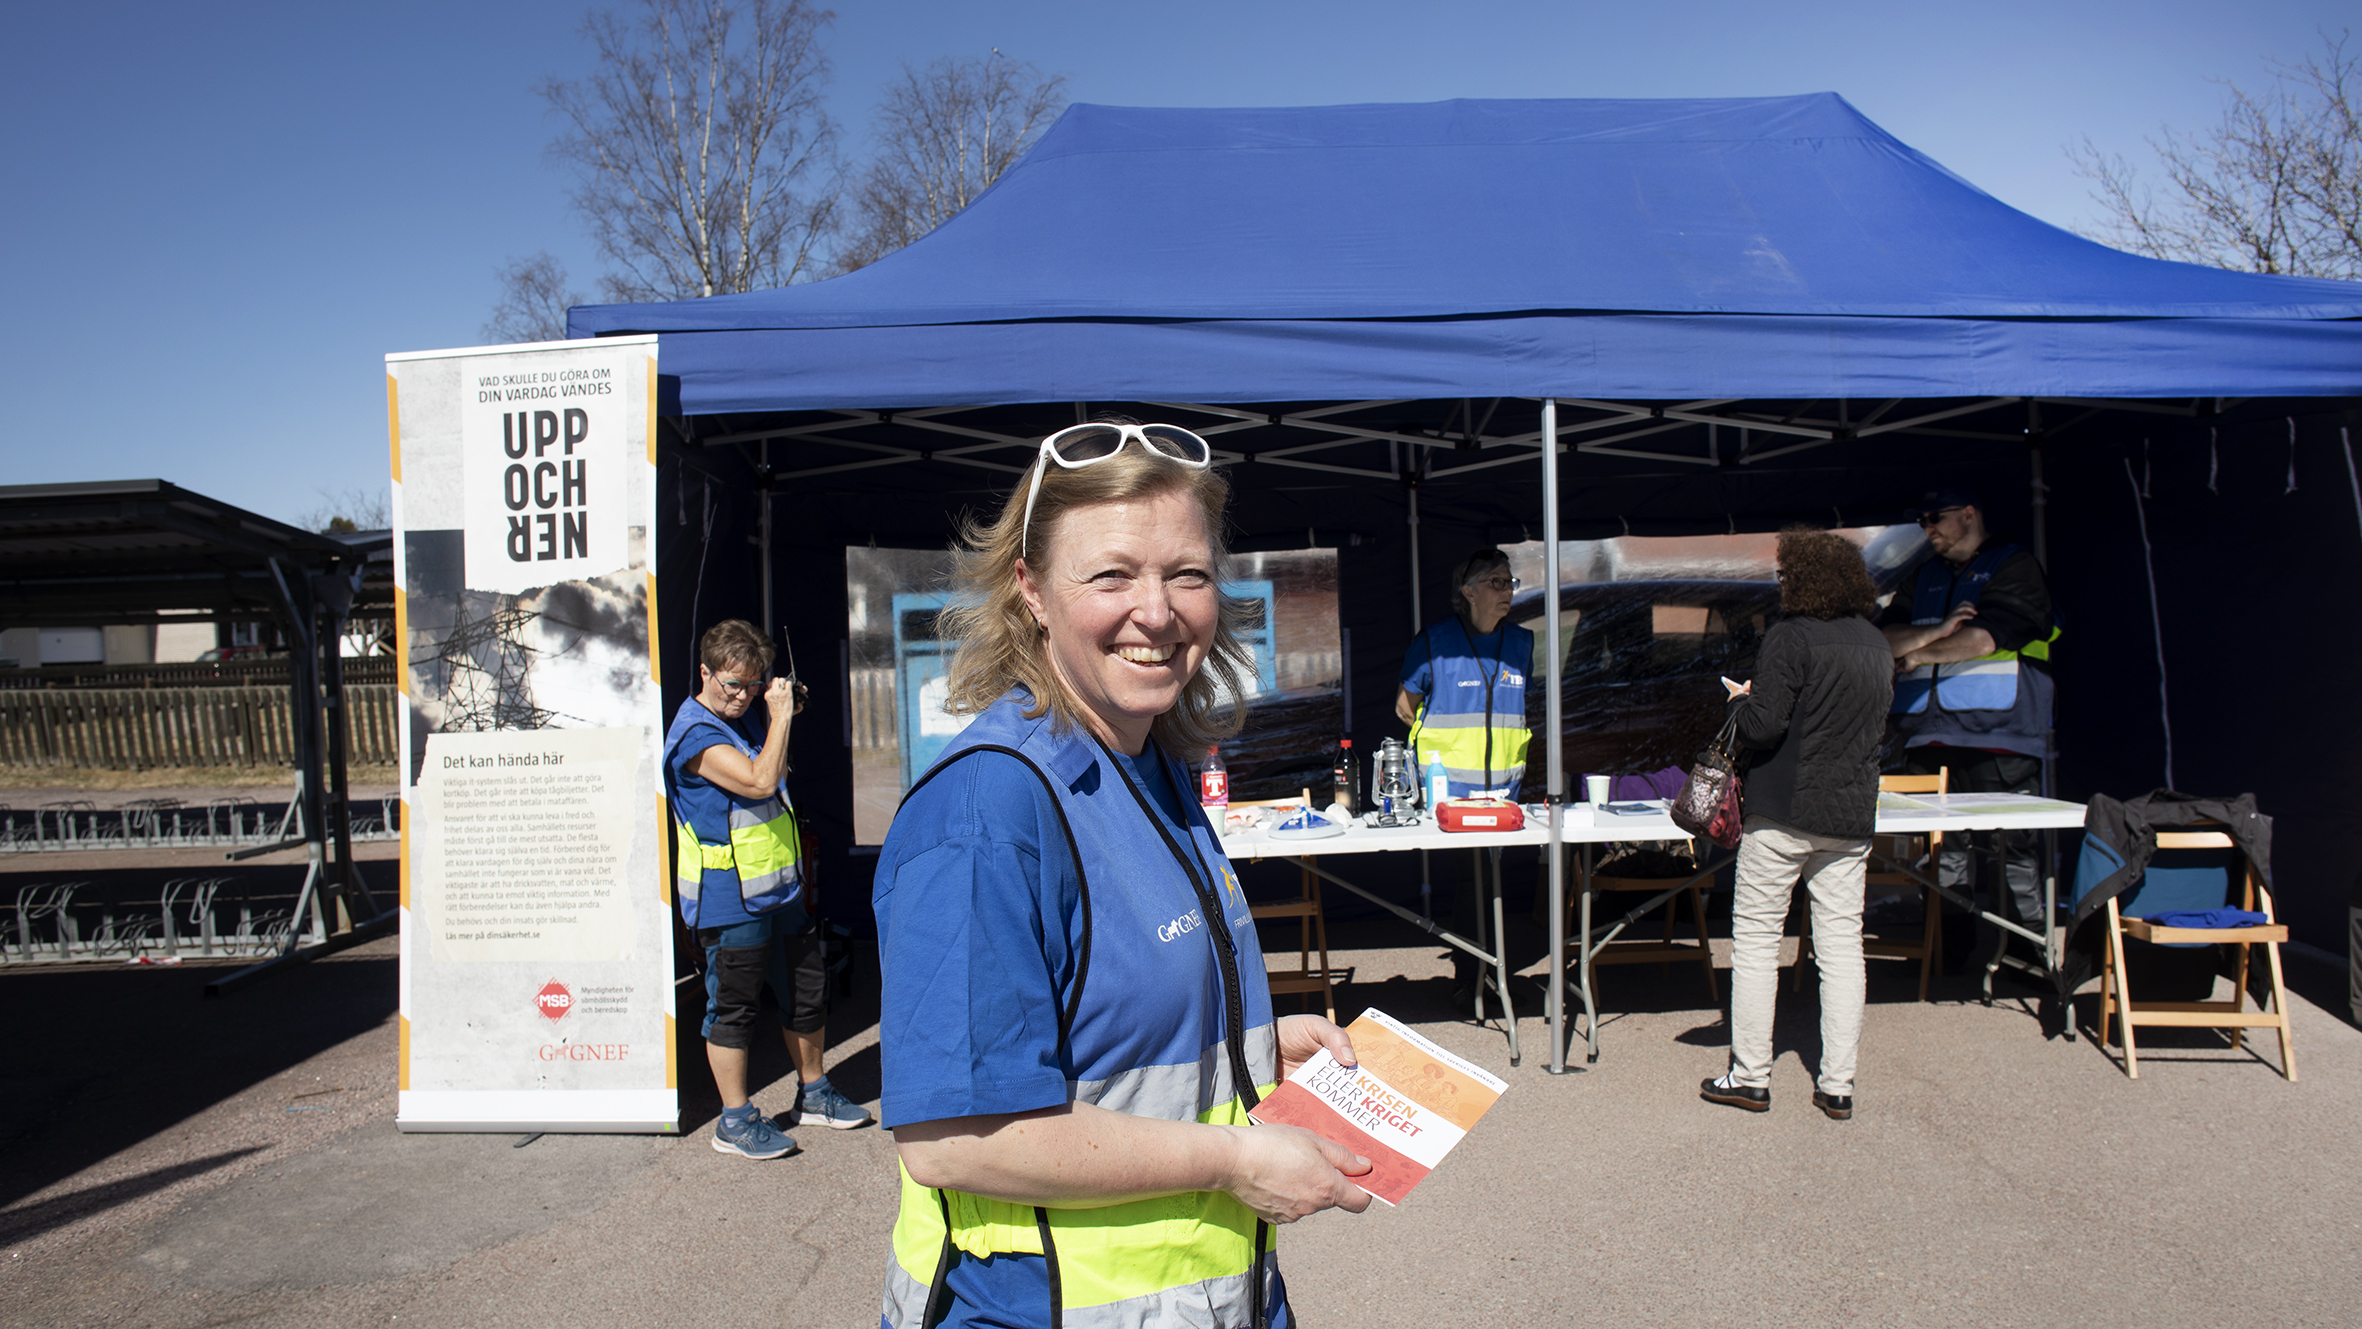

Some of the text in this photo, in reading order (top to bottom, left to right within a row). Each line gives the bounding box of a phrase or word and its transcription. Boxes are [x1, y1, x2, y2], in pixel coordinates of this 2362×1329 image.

[479, 368, 610, 386] VAD SKULLE DU GÖRA OM
[479, 382, 612, 403] DIN VARDAG VÄNDES
[503, 408, 588, 459] UPP
[504, 459, 586, 511] OCH
[507, 511, 588, 562] NER
[443, 752, 564, 769] Det kan hända här
[443, 777, 467, 788] Viktiga
[504, 775, 517, 784] slås
[519, 776, 529, 784] ut.
[531, 775, 542, 783] Det
[544, 774, 556, 785] går
[558, 774, 571, 783] inte
[573, 774, 583, 782] att
[585, 774, 601, 784] göra
[444, 784, 604, 799] kortköp. Det går inte att köpa tågbiljetter. Det
[444, 800, 455, 808] blir
[457, 799, 487, 810] problem
[489, 798, 506, 807] med
[508, 799, 518, 807] att
[520, 797, 541, 806] betala
[547, 796, 588, 806] mataffären.
[445, 813, 474, 822] Ansvaret
[476, 813, 486, 822] för
[488, 813, 498, 821] att
[509, 812, 520, 821] ska
[523, 811, 543, 820] kunna
[545, 811, 559, 820] leva
[565, 811, 579, 819] fred
[582, 810, 594, 819] och
[444, 825, 462, 833] frihet
[465, 824, 484, 833] delas
[510, 823, 526, 832] alla.
[528, 822, 566, 831] Samhällets
[445, 836, 465, 845] måste
[468, 835, 484, 844] först
[497, 835, 507, 843] till
[520, 835, 536, 843] mest
[538, 834, 565, 842] utsatta.
[579, 833, 598, 841] flesta
[445, 847, 473, 856] behöver
[475, 846, 493, 855] klara
[495, 846, 506, 857] sig
[508, 846, 528, 857] själva
[540, 845, 551, 854] tid.
[553, 844, 585, 853] Förbered
[587, 844, 599, 855] dig
[600, 844, 610, 852] för
[445, 859, 454, 867] att
[456, 858, 474, 867] klara
[476, 857, 510, 868] vardagen
[512, 857, 522, 865] för
[524, 857, 535, 867] dig
[537, 856, 552, 867] själv
[554, 856, 567, 865] och
[569, 856, 584, 864] dina
[586, 856, 603, 864] nära
[445, 869, 480, 878] samhället
[482, 869, 496, 877] inte
[498, 868, 529, 879] fungerar
[584, 866, 596, 875] vid.
[599, 866, 611, 875] Det
[445, 880, 478, 891] viktigaste
[490, 880, 500, 888] att
[514, 878, 558, 889] dricksvatten,
[560, 878, 574, 887] mat
[576, 878, 589, 886] och
[591, 877, 616, 887] värme,
[446, 892, 457, 900] och
[459, 892, 469, 900] att
[472, 891, 494, 900] kunna
[506, 891, 525, 899] emot
[527, 890, 545, 901] viktig
[547, 889, 592, 898] information.
[594, 888, 610, 897] Med
[446, 903, 457, 911] rätt
[459, 902, 508, 911] förberedelser
[510, 901, 523, 910] kan
[536, 901, 553, 909] även
[554, 900, 576, 911] hjälpa
[578, 900, 602, 908] andra.
[457, 917, 483, 926] behövs
[485, 916, 498, 925] och
[500, 916, 511, 925] din
[514, 916, 534, 924] insats
[536, 916, 548, 926] gör
[550, 914, 579, 923] skillnad.
[446, 932, 457, 940] Läs
[487, 930, 540, 939] dinsäkerhet.se
[539, 995, 570, 1008] MSB
[1328, 1057, 1418, 1120] OM KRISEN
[1307, 1074, 1380, 1131] KOMMER
[1317, 1066, 1423, 1137] ELLER KRIGET
